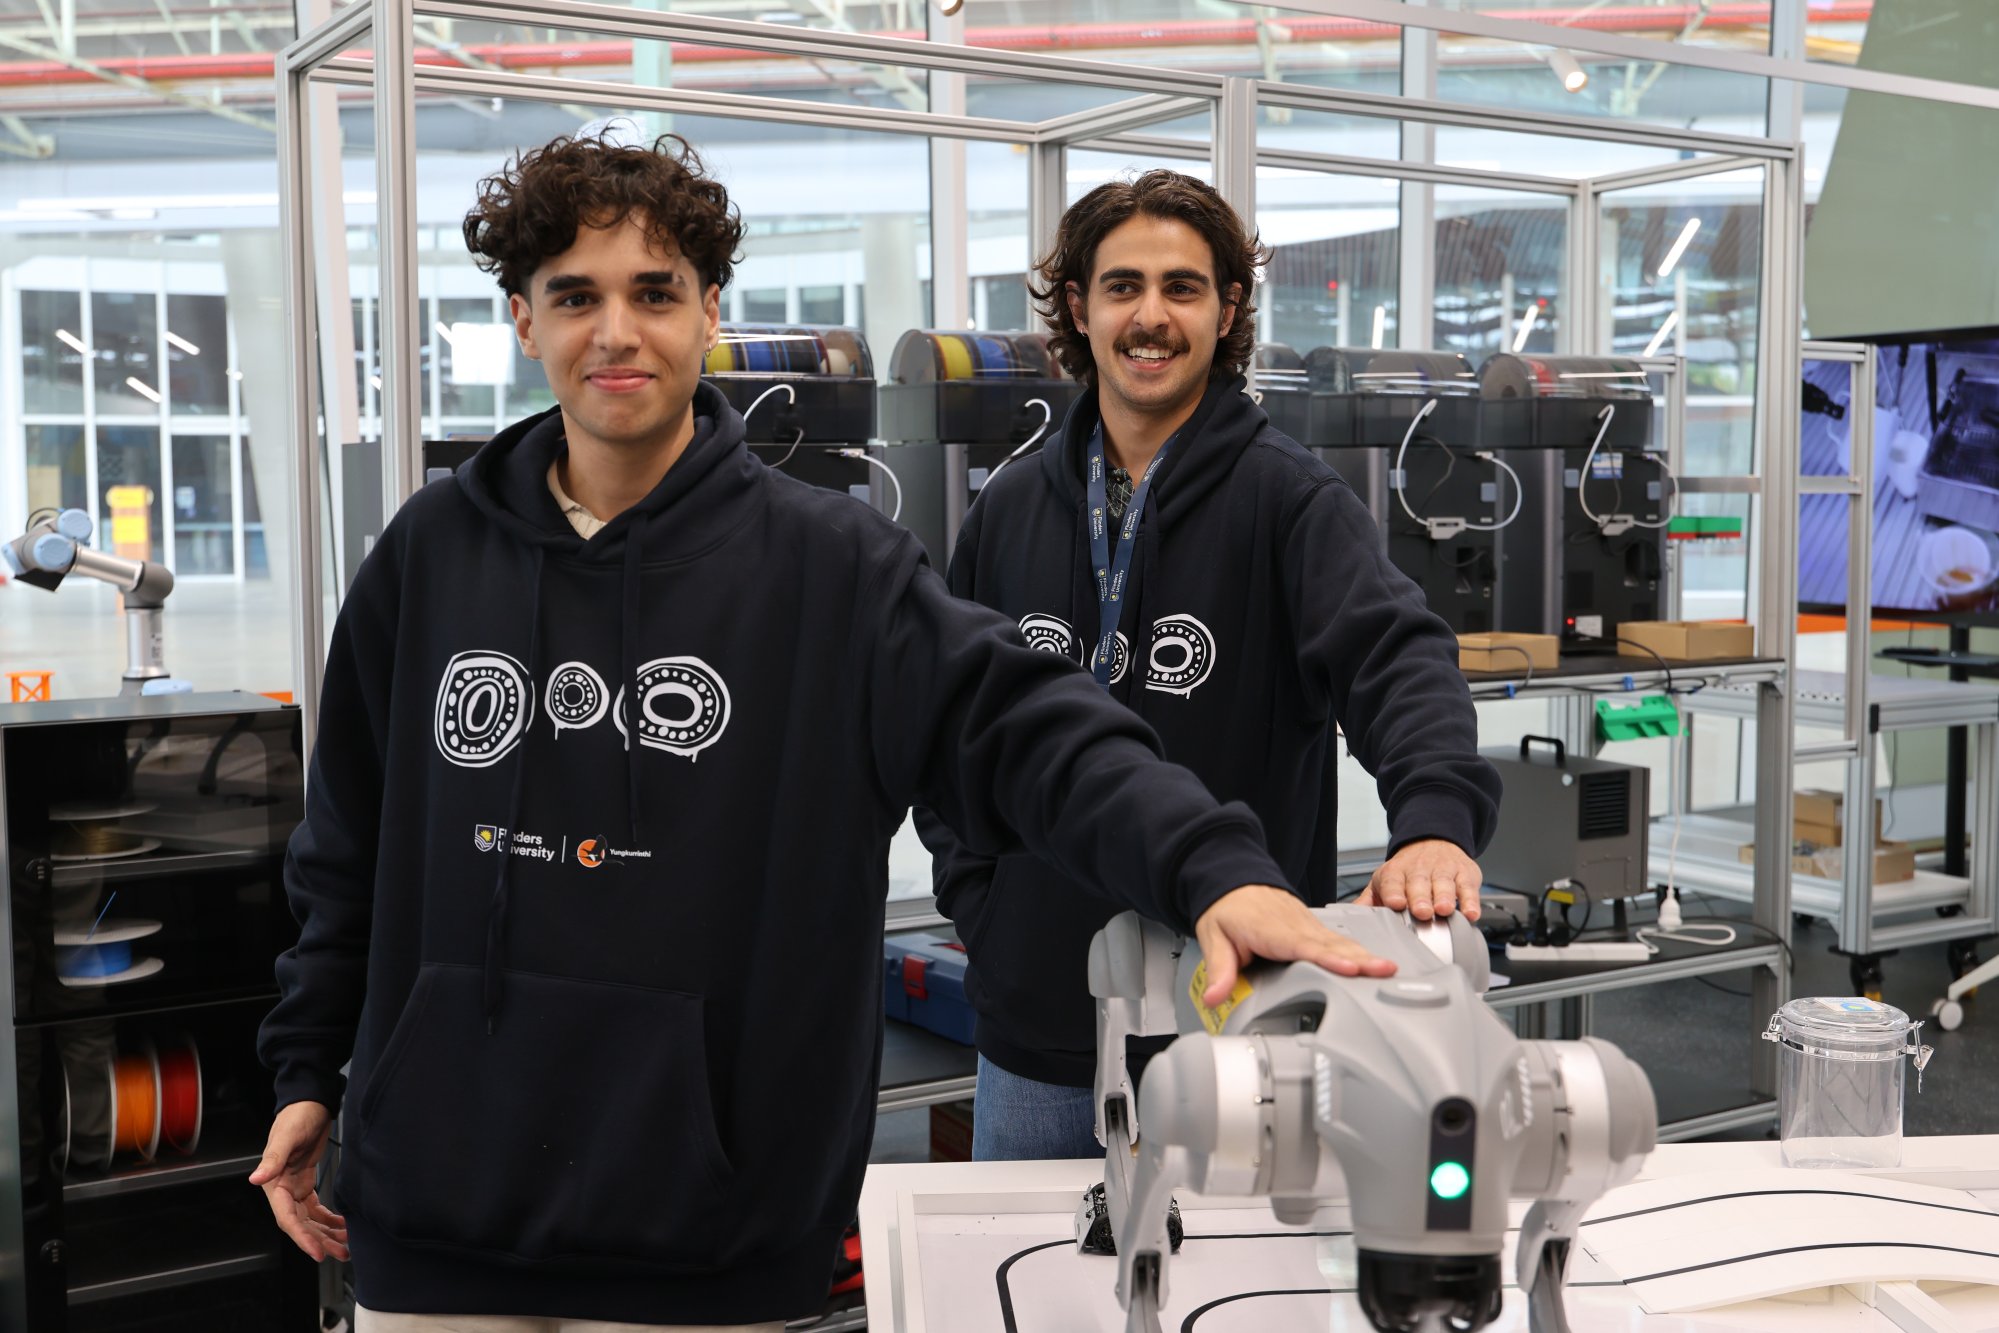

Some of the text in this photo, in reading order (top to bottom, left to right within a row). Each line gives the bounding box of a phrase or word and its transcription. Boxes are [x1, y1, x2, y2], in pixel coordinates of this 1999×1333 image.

[1124, 512, 1133, 530] Flinders
[1128, 508, 1139, 530] University
[1111, 573, 1119, 592] Flinders
[1115, 569, 1125, 592] University
[1104, 631, 1112, 654] University
[498, 828, 543, 845] Flnders
[497, 840, 555, 861] Uiversity
